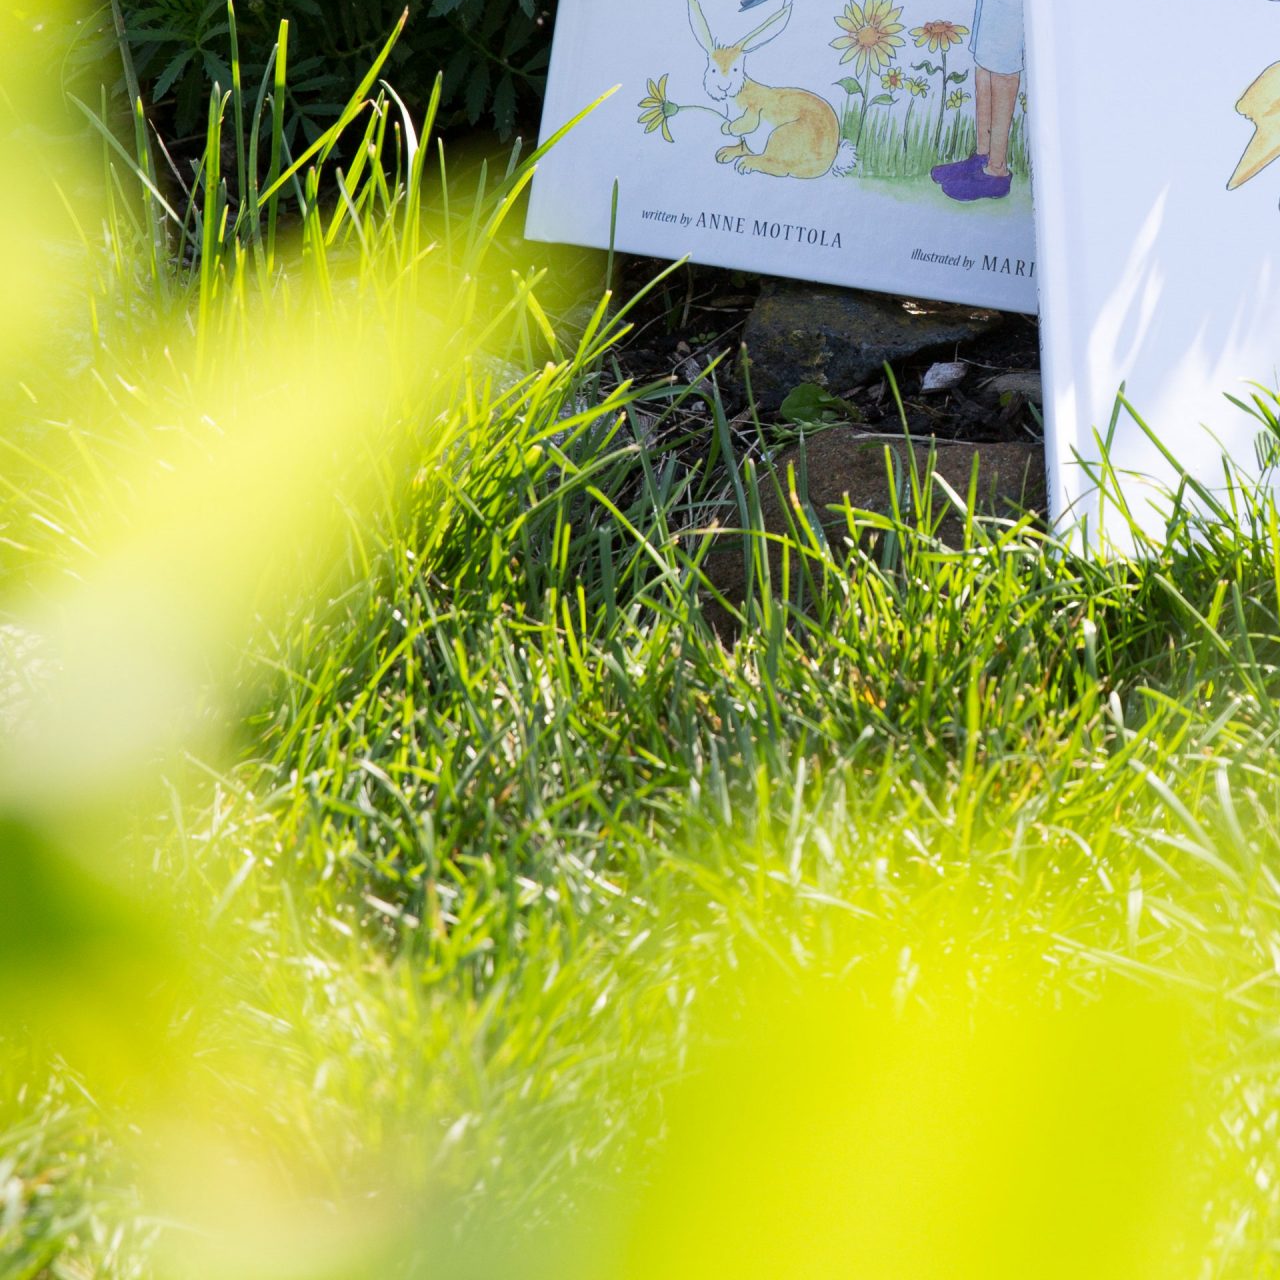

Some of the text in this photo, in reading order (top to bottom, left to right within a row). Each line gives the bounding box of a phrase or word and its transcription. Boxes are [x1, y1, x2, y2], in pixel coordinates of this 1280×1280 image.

[641, 208, 843, 249] written by ANNE MOTTOLA
[911, 248, 1036, 278] illustrated by MARI
